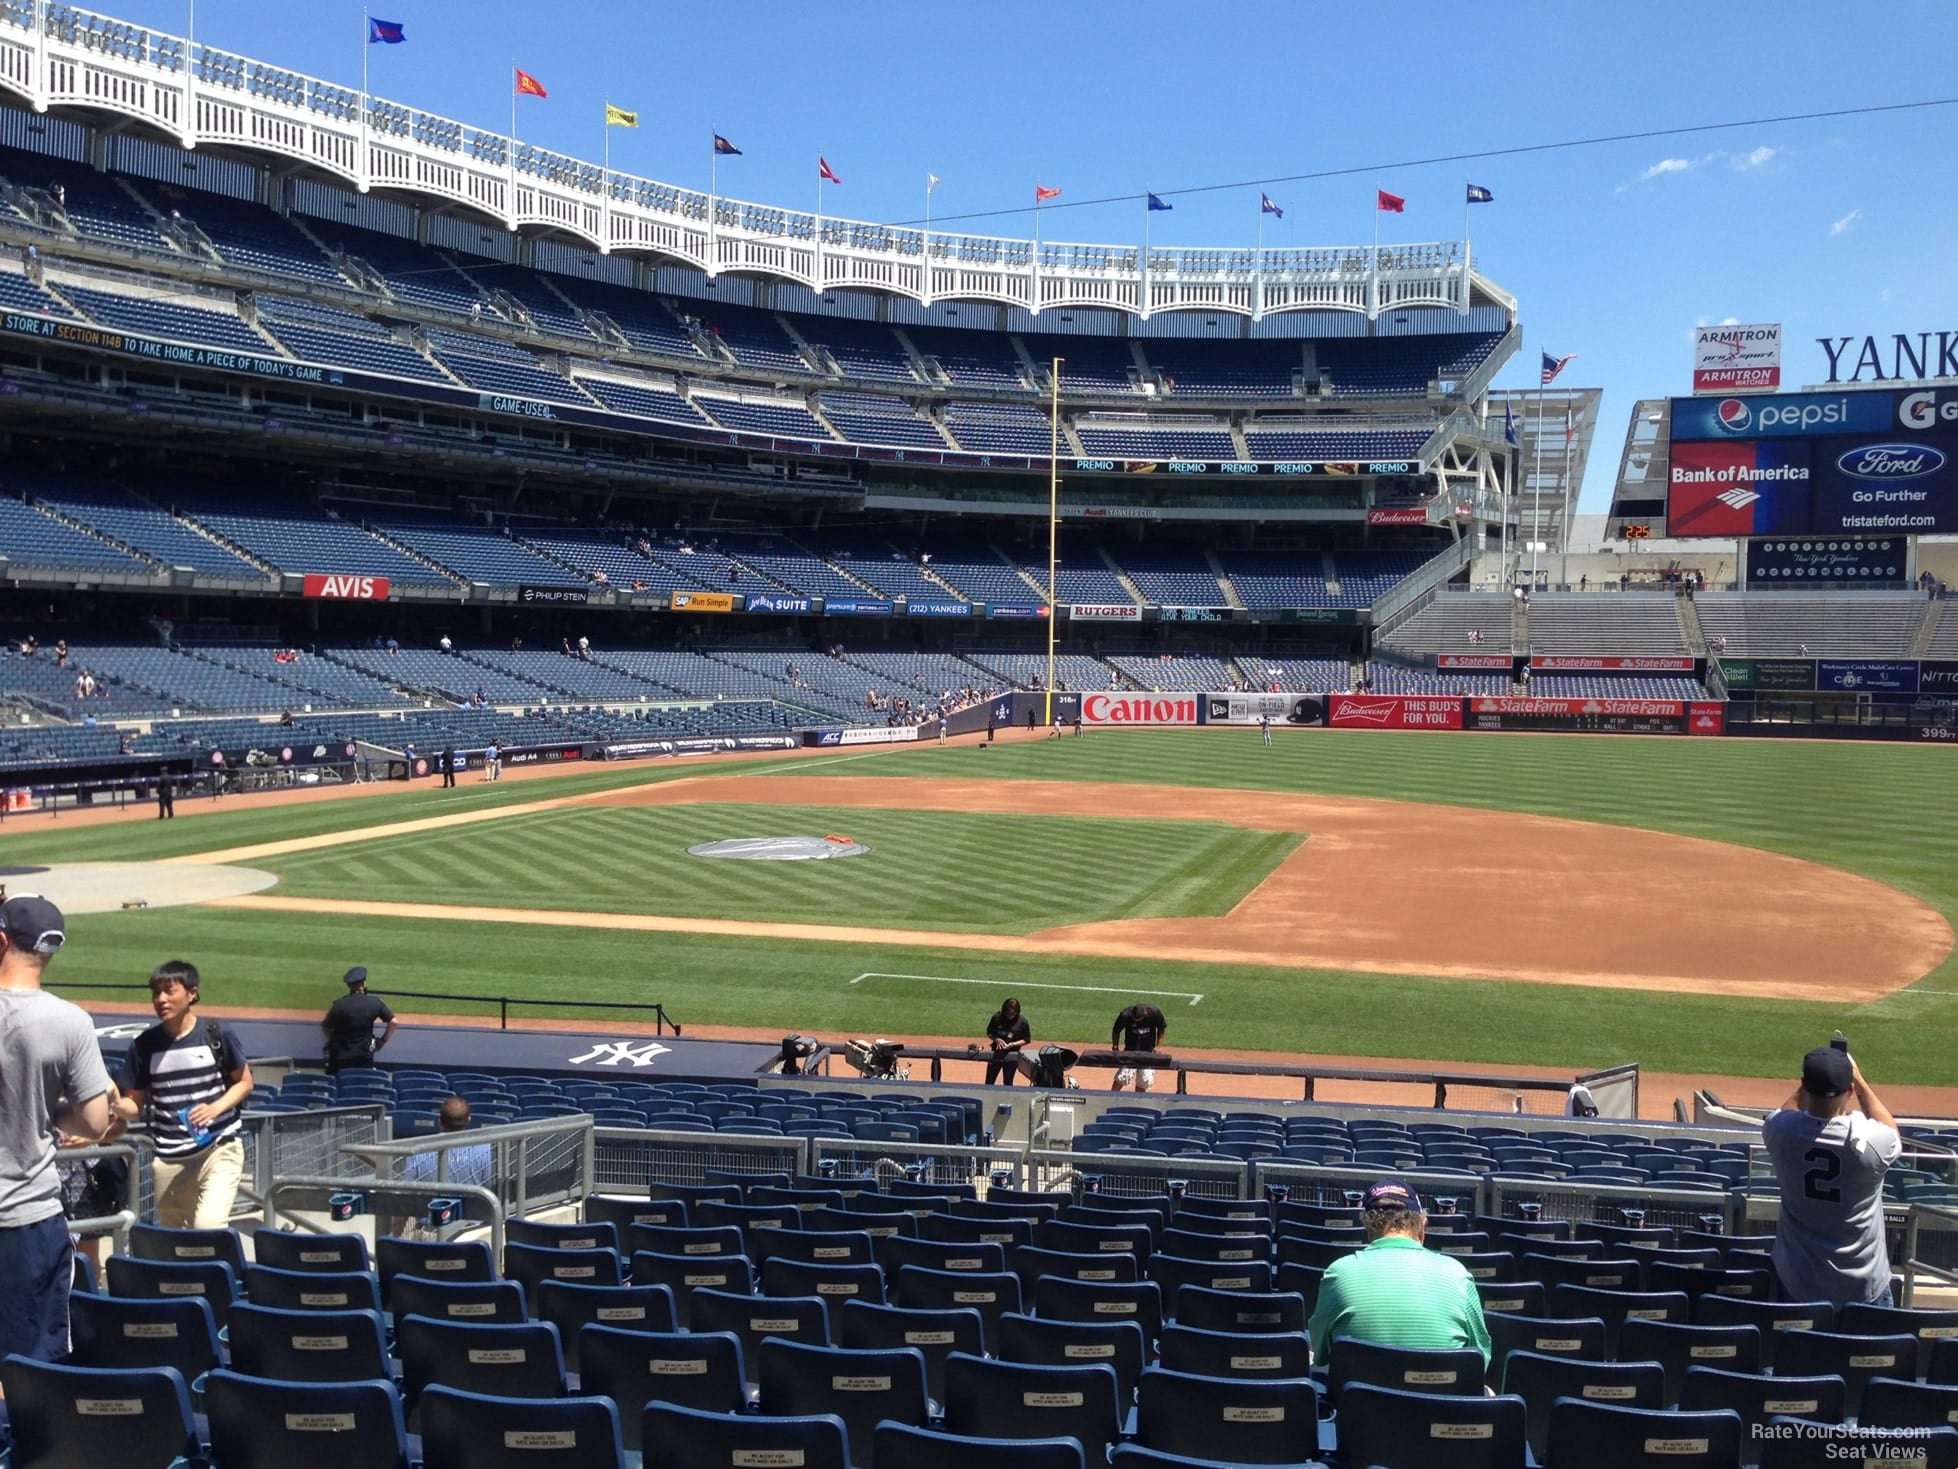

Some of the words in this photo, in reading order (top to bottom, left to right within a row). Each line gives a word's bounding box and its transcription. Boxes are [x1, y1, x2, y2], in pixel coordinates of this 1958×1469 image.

[1699, 330, 1777, 343] ARMITRON
[6, 315, 39, 333] STORE
[42, 323, 55, 336] AT
[58, 326, 99, 345] SECTION
[101, 335, 122, 349] 114B
[124, 338, 136, 351] TO
[138, 340, 161, 356] TAKE
[164, 345, 194, 362] HOME
[196, 351, 204, 363] A
[206, 352, 235, 368] PIECE
[238, 357, 251, 370] OF
[254, 360, 294, 377] TODAY'S
[296, 367, 323, 381] GAME
[1701, 369, 1772, 382] ARMITRON
[1759, 398, 1848, 431] pepsi
[1076, 460, 1114, 471] PREMIO
[1857, 448, 1925, 474] Ford
[1168, 462, 1206, 473] PREMIO
[1220, 463, 1258, 474] PREMIO
[1273, 463, 1312, 474] PREMIO
[1369, 462, 1409, 473] PREMIO
[1672, 467, 1716, 483] Bank
[1717, 466, 1736, 481] of
[1737, 464, 1809, 481] America
[1852, 491, 1873, 502] Go
[1875, 490, 1927, 502] Further
[1370, 511, 1425, 524] Budweiser
[1842, 514, 1935, 527] tristateford.com
[320, 577, 374, 598] AVIS
[535, 591, 561, 601] PHILIP
[563, 592, 587, 601] STEIN
[692, 597, 705, 606] Run
[706, 597, 729, 607] Simple
[776, 600, 807, 610] SUITE
[909, 605, 928, 613] (212)
[929, 605, 968, 614] YANKEES
[1075, 606, 1137, 617] RUTGERS
[1083, 694, 1196, 724] Canon
[1341, 703, 1392, 717] Budweiser
[1403, 701, 1423, 711] THIS
[1426, 701, 1460, 711] BUD'S
[1403, 713, 1421, 724] FOR
[1423, 713, 1449, 724] YOU.
[511, 754, 527, 762] Audi
[527, 753, 538, 761] A4
[1803, 1147, 1841, 1203] 2
